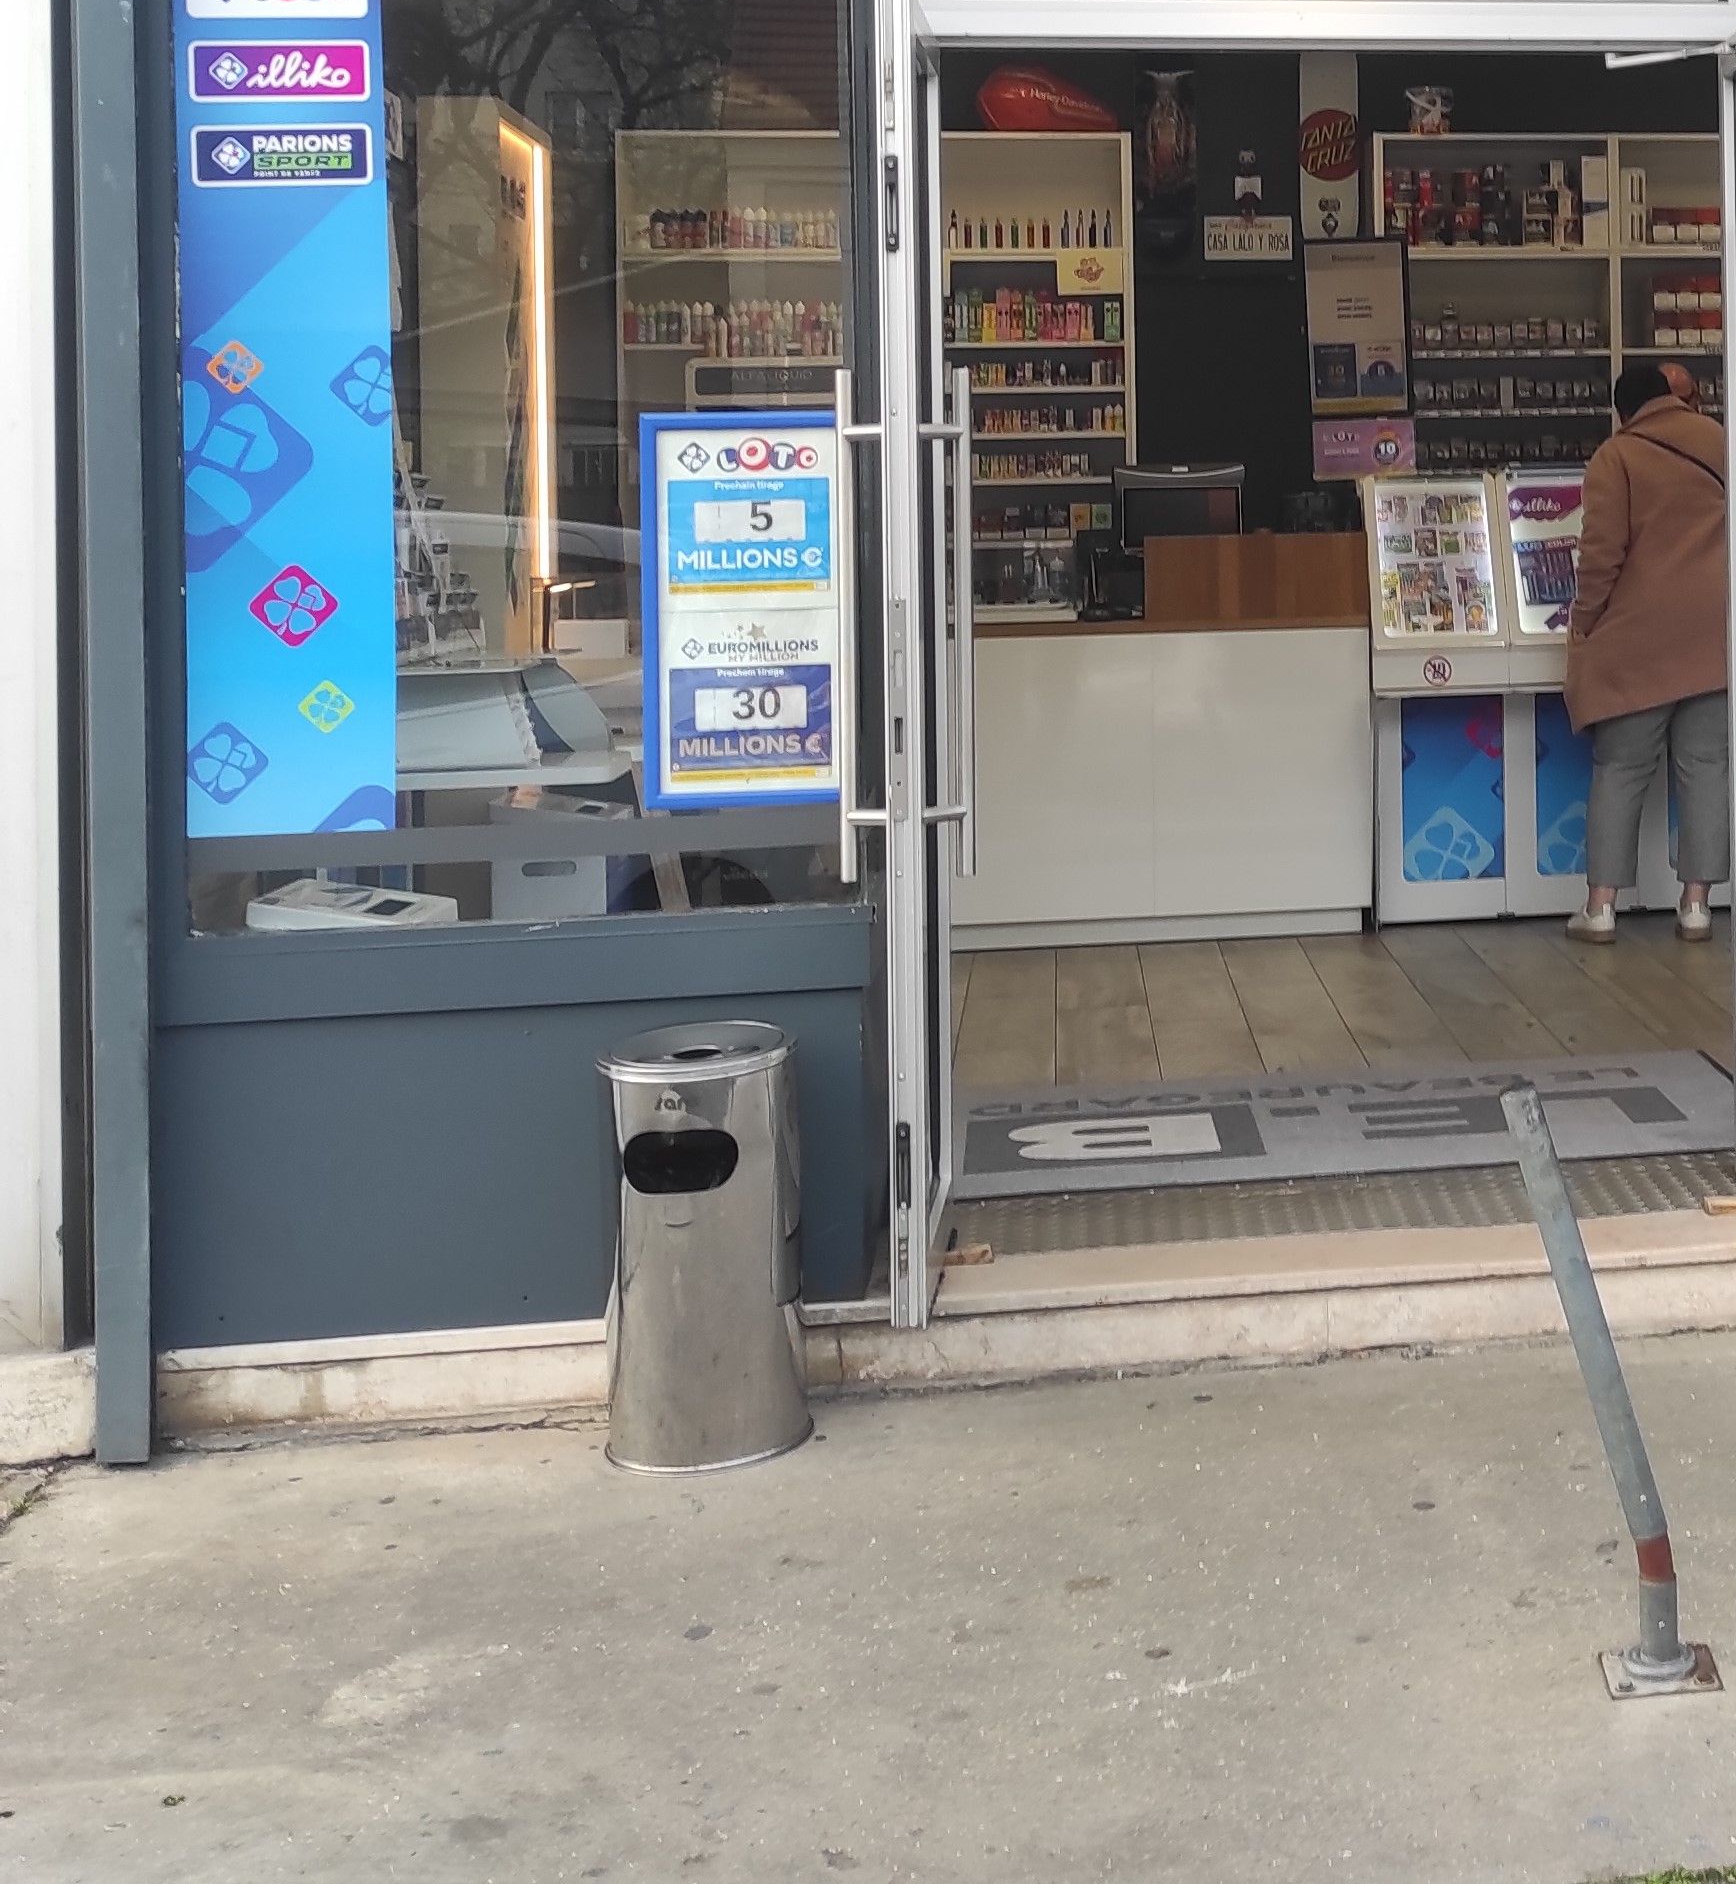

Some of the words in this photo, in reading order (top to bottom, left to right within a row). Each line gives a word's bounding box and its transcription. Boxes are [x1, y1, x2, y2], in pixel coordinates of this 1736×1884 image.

[246, 51, 351, 88] illiko
[252, 134, 352, 153] PARIONS
[257, 155, 349, 167] SPORT
[1207, 233, 1228, 251] CASA
[1259, 233, 1264, 252] Y
[1268, 233, 1290, 252] ROSA
[717, 438, 818, 472] LOTO
[1379, 442, 1396, 455] 10
[750, 500, 773, 531] 5
[678, 548, 798, 570] MILLIONS
[708, 639, 819, 654] EUROMILLIONS
[732, 688, 781, 720] 30
[679, 734, 802, 758] MILLIONS
